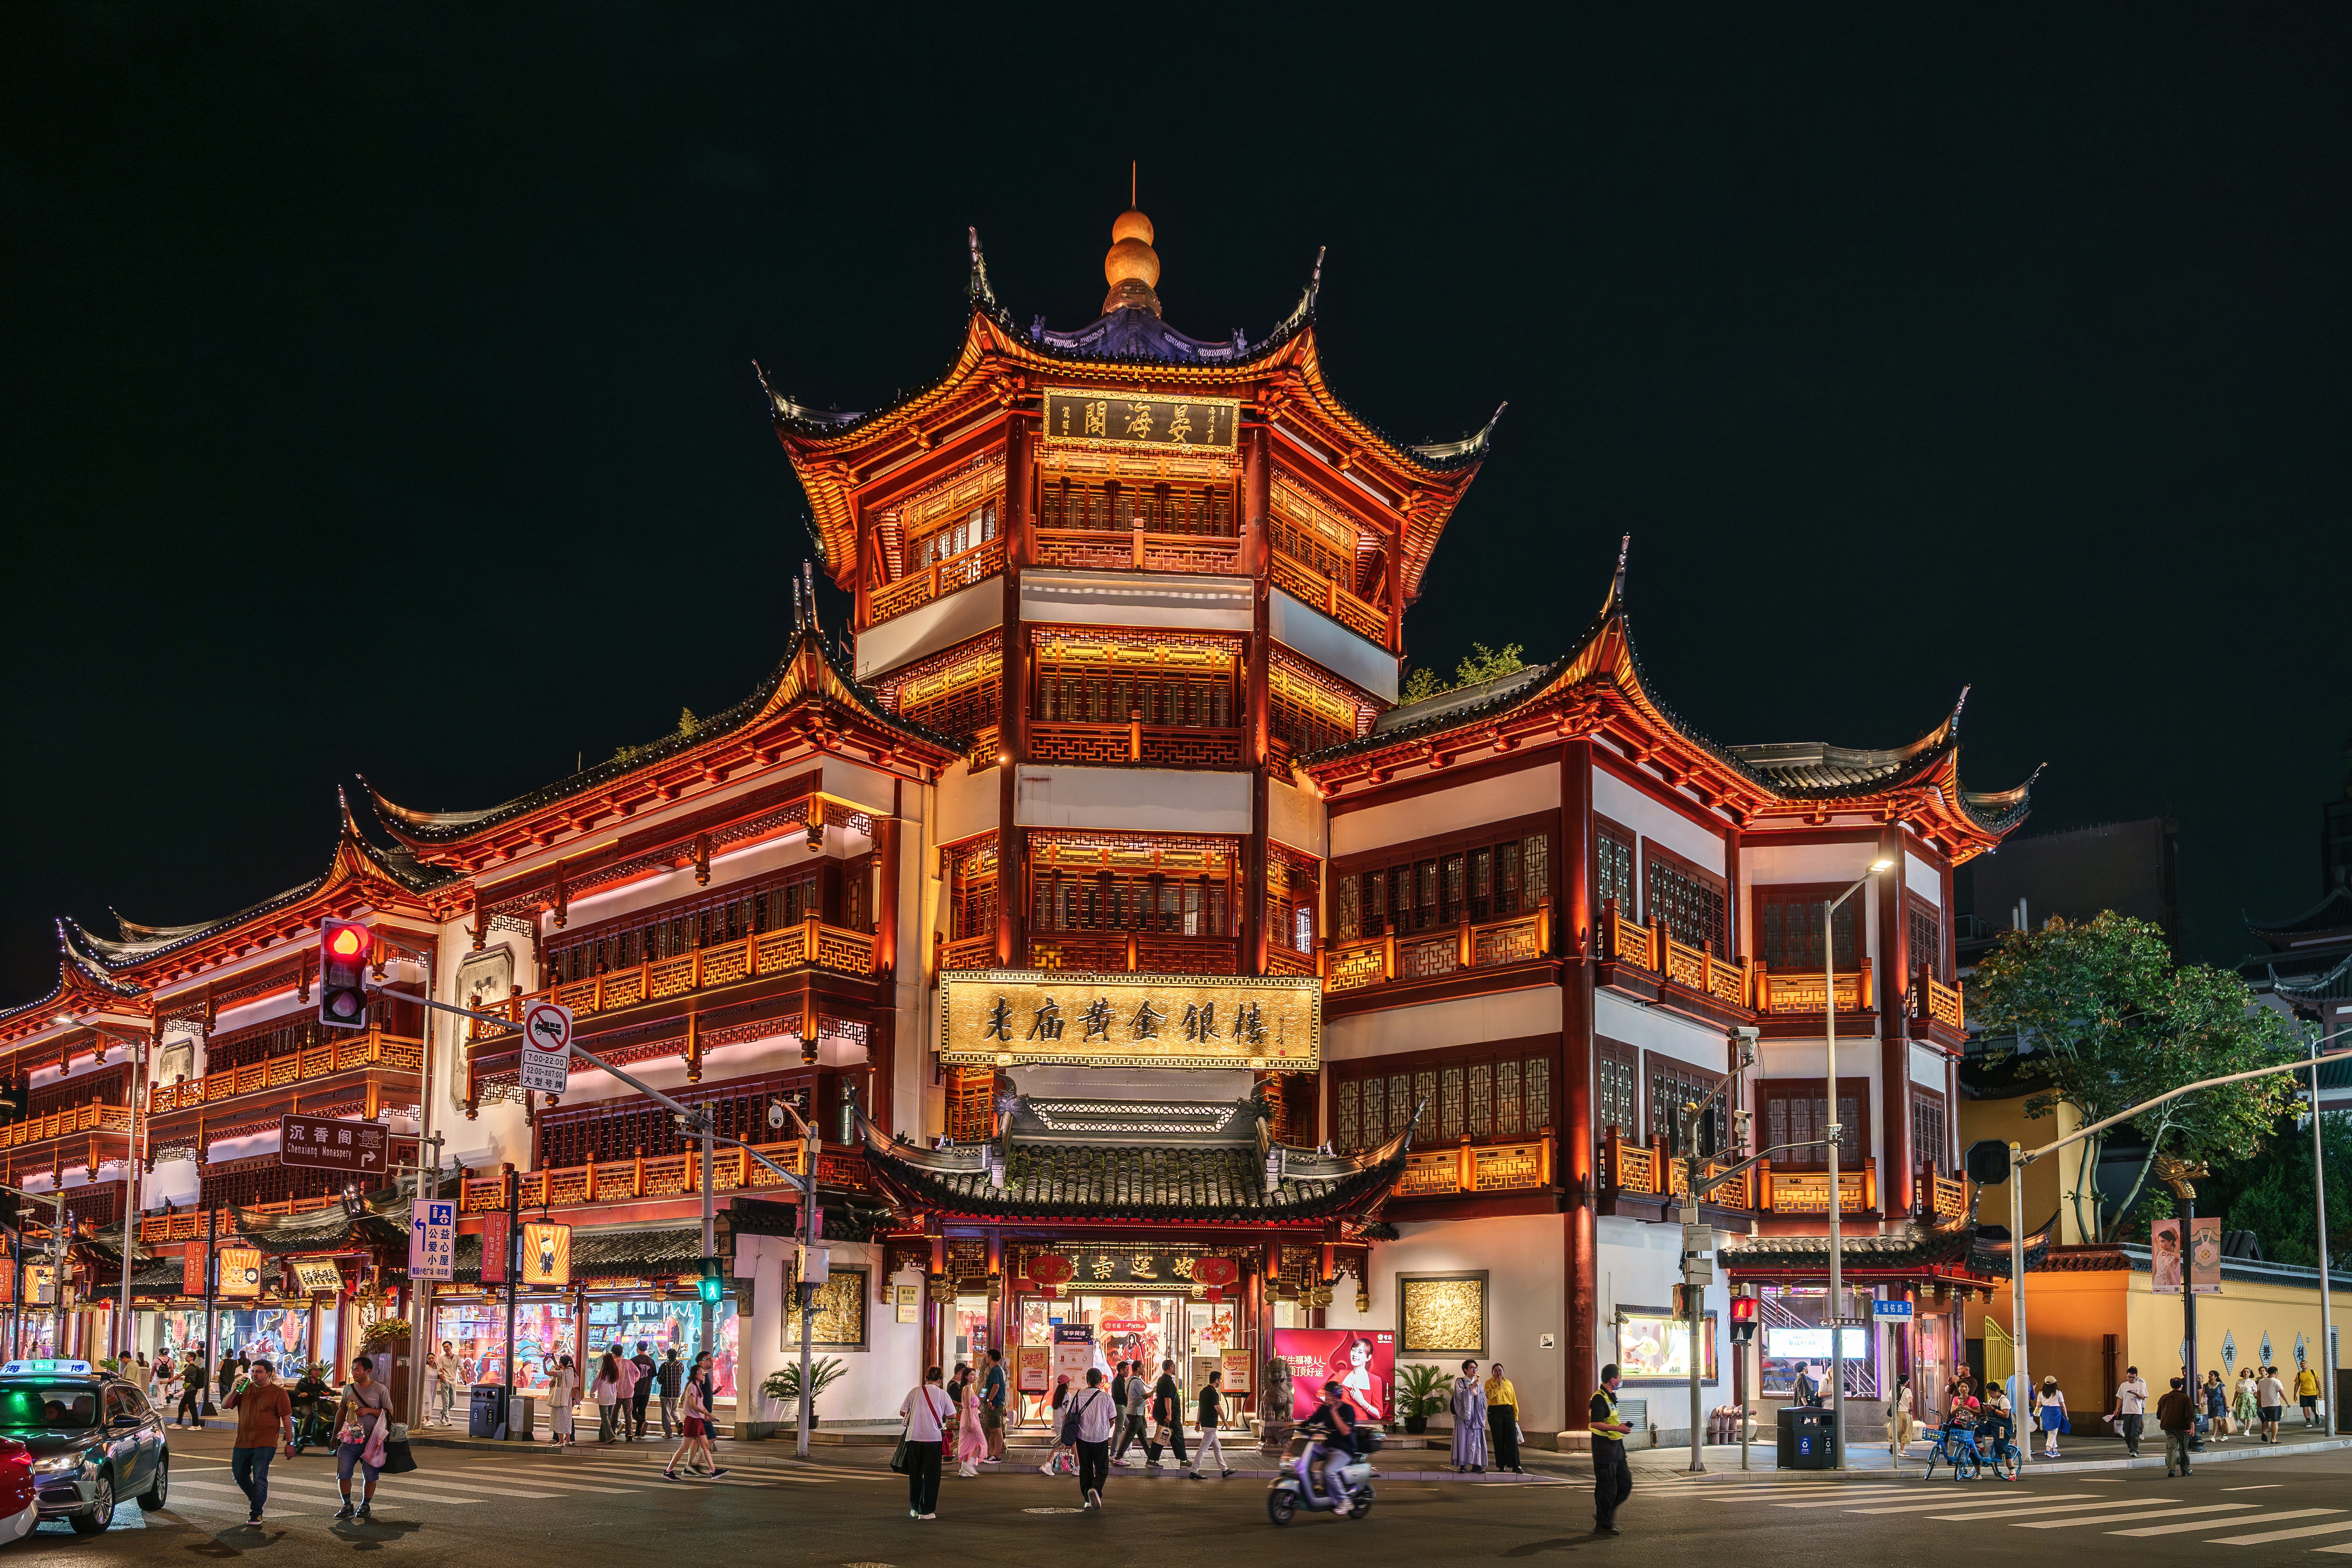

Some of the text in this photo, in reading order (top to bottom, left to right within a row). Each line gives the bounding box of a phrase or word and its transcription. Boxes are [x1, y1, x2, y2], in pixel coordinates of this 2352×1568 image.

[528, 1053, 564, 1066] 7:00-22:00
[526, 1066, 563, 1079] 22:00-次日7:00
[524, 1075, 563, 1090] 大型号牌
[289, 1125, 352, 1145] 沉香阁
[287, 1142, 352, 1161] Chenxiang Monaspery
[428, 1228, 450, 1239] 公益
[428, 1241, 449, 1252] 爱心
[427, 1254, 449, 1265] 小屋
[1032, 1261, 1070, 1278] 欢度
[1883, 1303, 1903, 1313] 福佑路
[5, 1365, 21, 1373] 海
[35, 1361, 54, 1370] 待运
